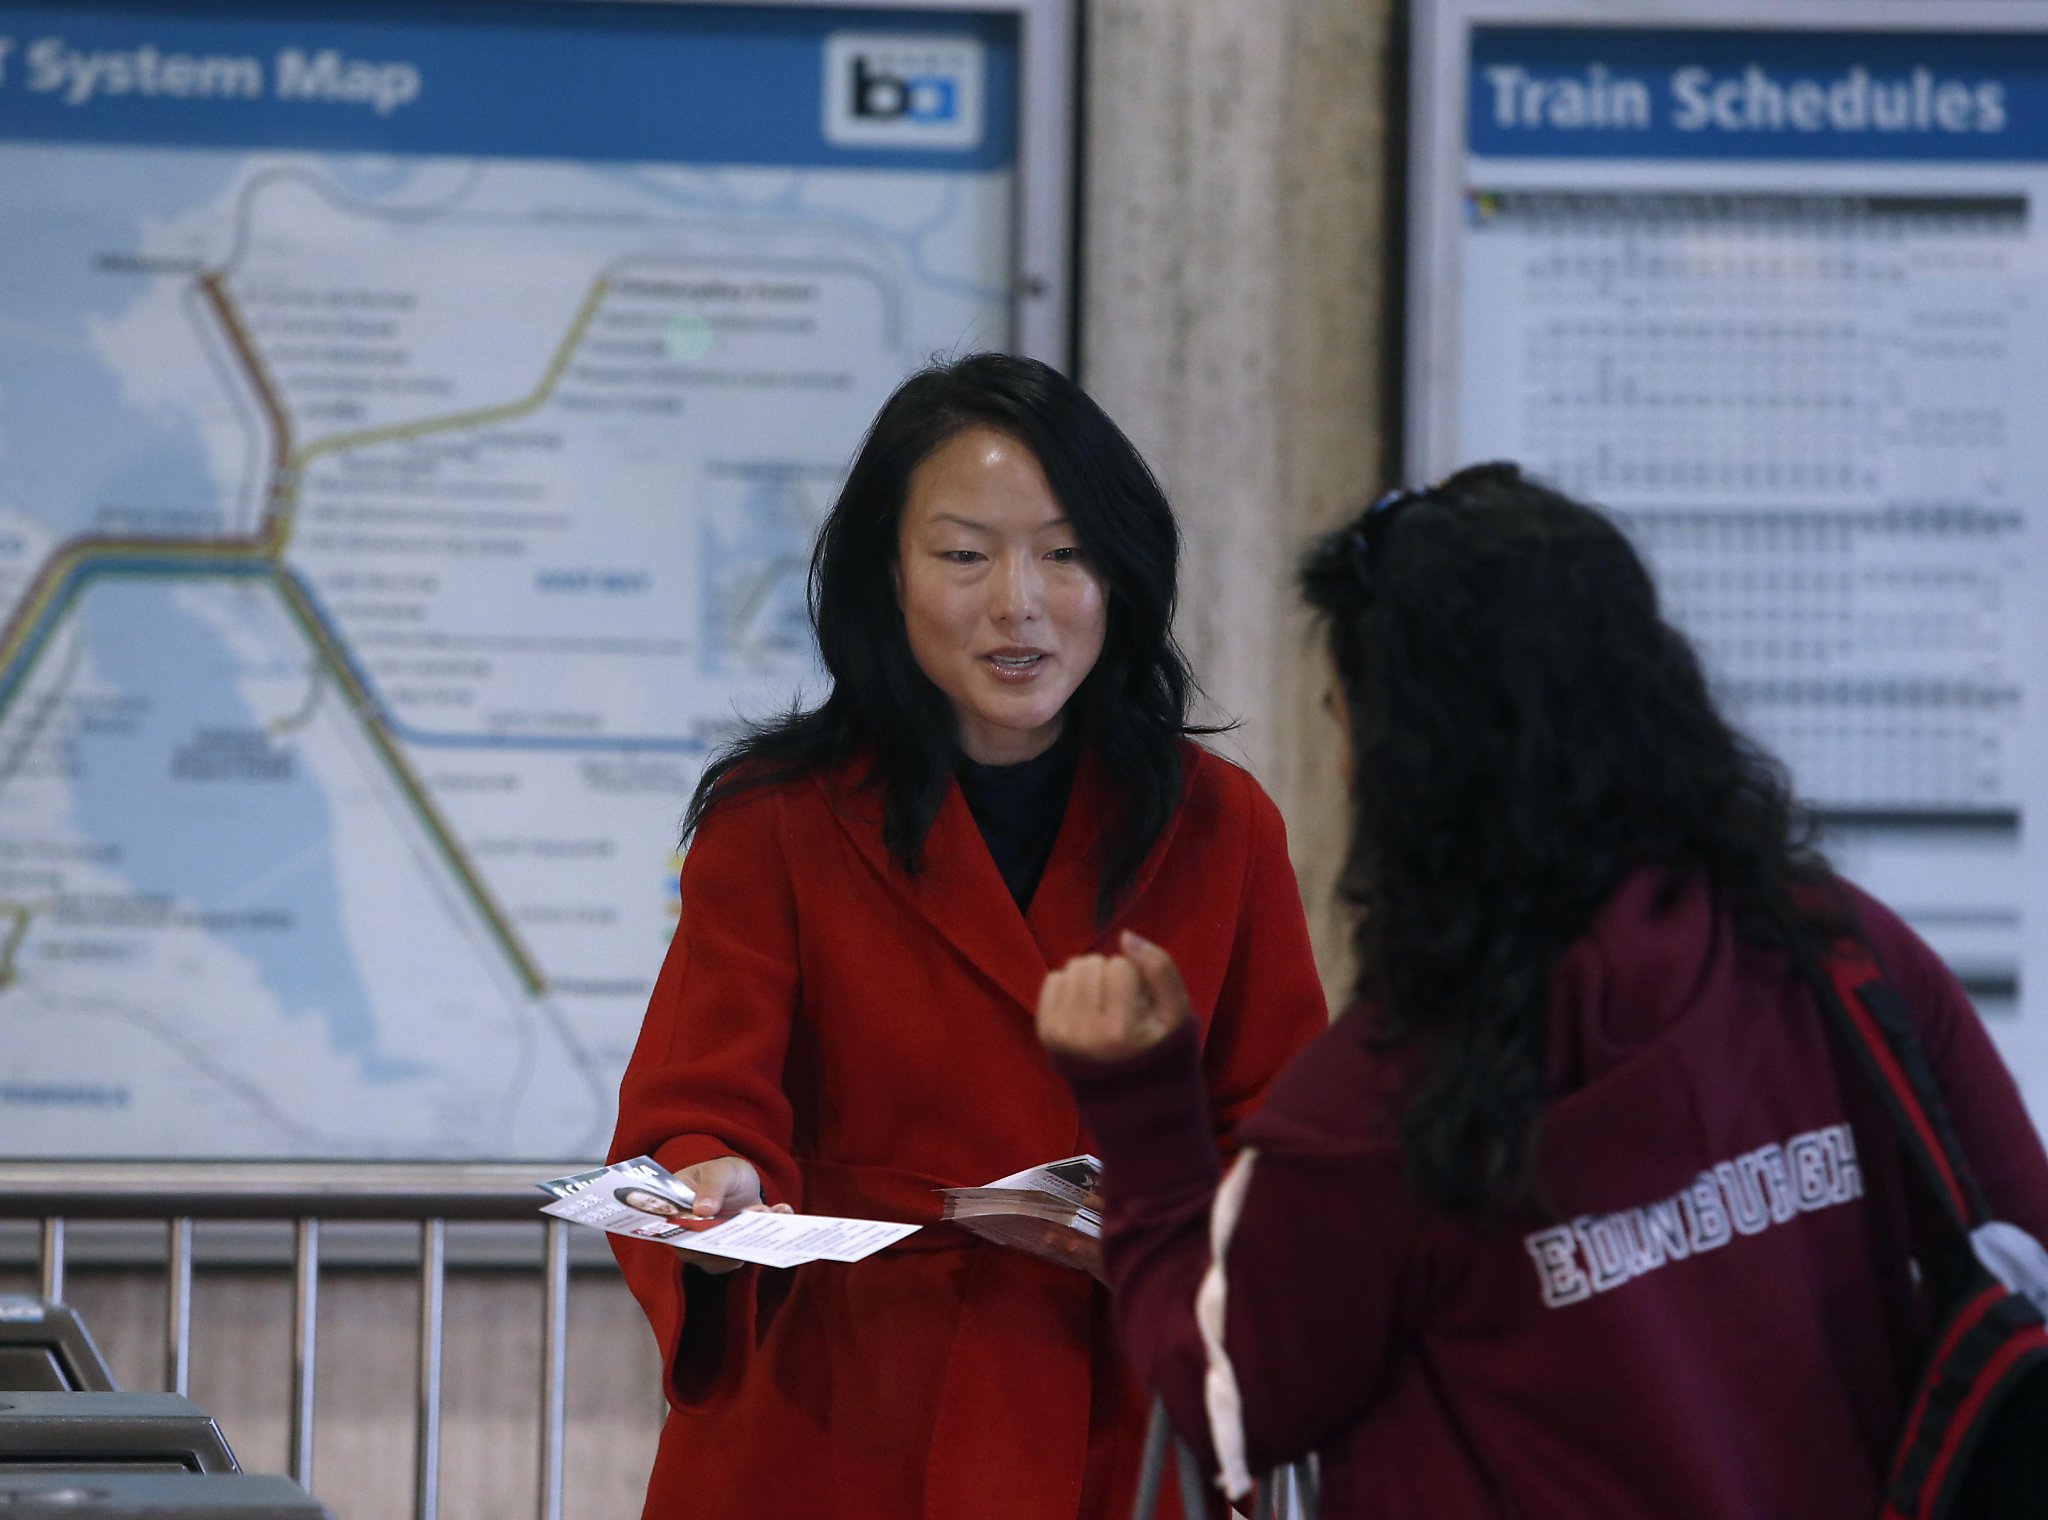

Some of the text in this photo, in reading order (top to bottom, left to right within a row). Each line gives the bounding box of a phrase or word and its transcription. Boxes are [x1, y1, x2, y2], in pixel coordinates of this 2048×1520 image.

[27, 38, 262, 105] System
[276, 48, 421, 115] Map
[1486, 63, 2008, 131] Train Schedules
